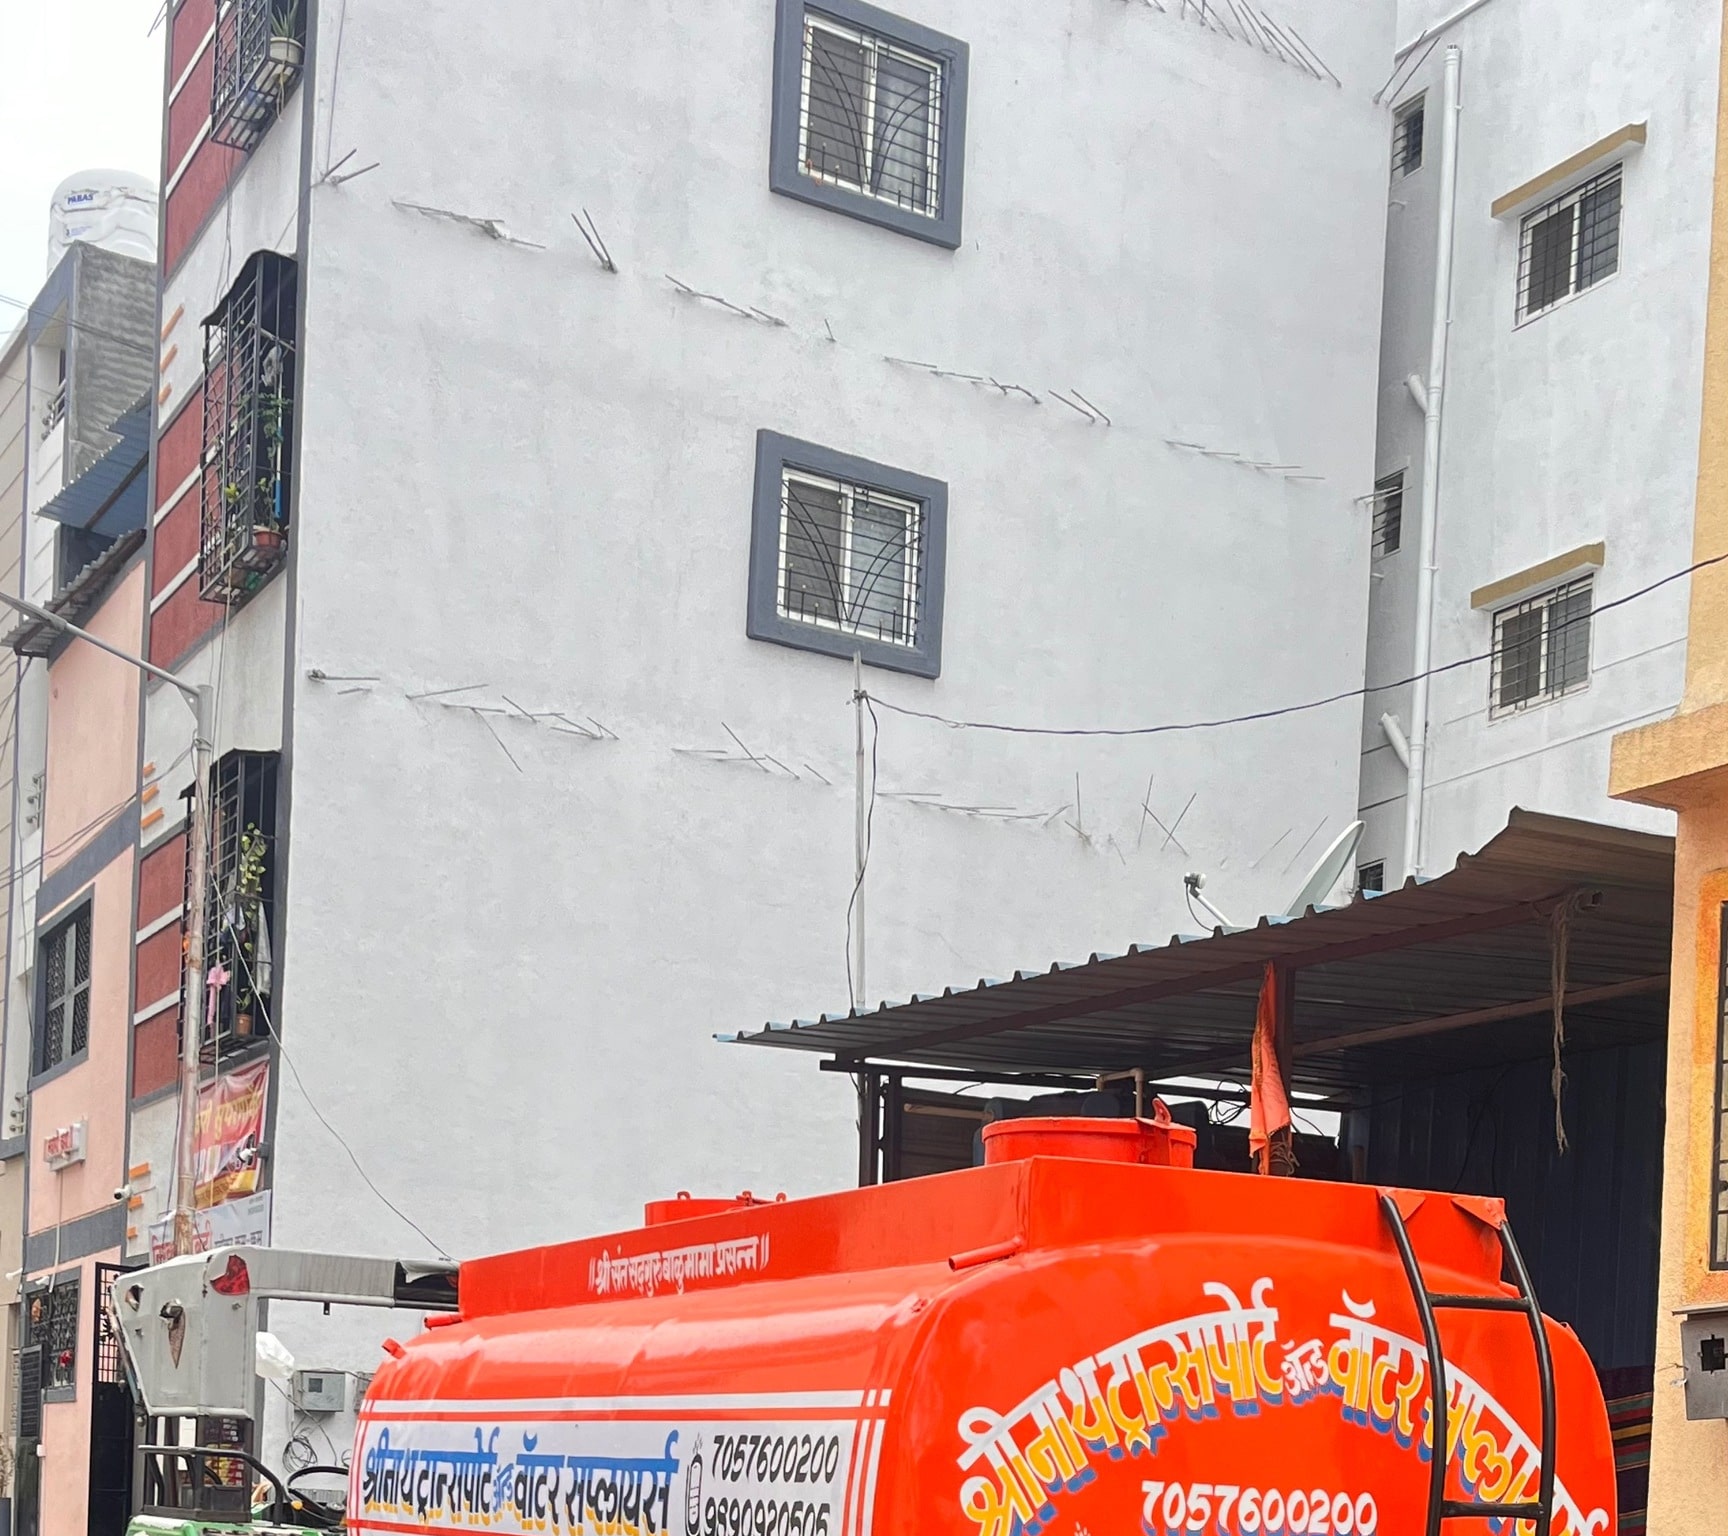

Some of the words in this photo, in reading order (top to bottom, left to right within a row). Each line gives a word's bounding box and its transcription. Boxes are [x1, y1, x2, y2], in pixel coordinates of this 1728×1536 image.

[610, 1244, 629, 1293] संत
[715, 1235, 759, 1276] प्रसन्न
[1094, 1277, 1283, 1457] ट्रान्सपोर्ट
[1327, 1288, 1430, 1448] वॉटर
[363, 1427, 415, 1515] श्रीनाथ
[416, 1426, 500, 1526] ट्रान्सपोर्ट
[514, 1430, 565, 1536] वॉटर
[712, 1434, 839, 1484] 7057600200
